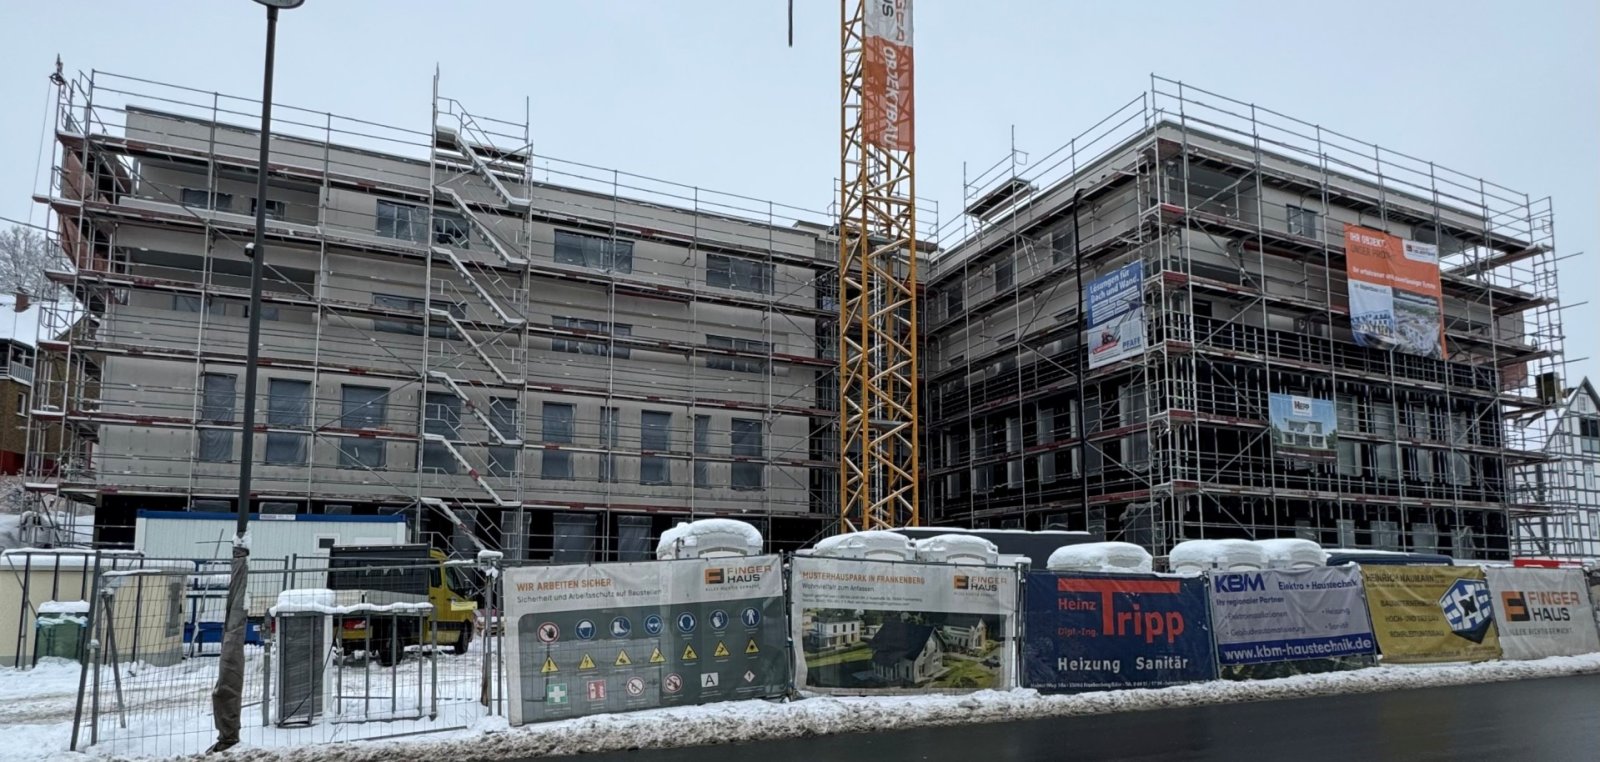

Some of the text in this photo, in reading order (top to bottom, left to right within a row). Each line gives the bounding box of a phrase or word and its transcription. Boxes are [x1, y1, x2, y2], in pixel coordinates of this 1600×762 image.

[883, 46, 899, 148] OBJEKTBAU
[1090, 269, 1130, 293] Lösungen für
[1091, 291, 1106, 303] Dach
[1106, 284, 1119, 296] und
[727, 565, 772, 575] FINGER
[517, 578, 612, 592] WIR ARBEITEN SICHER
[727, 573, 760, 583] HAUS
[802, 571, 867, 582] MUSTERHAUSPARK
[876, 576, 925, 585] FRANKENBERG
[971, 576, 1007, 585] FINGER
[1214, 573, 1265, 593] KBM
[1278, 581, 1304, 591] Elektro
[1312, 579, 1357, 590] Haustechnik
[971, 584, 998, 592] HAUS
[517, 593, 552, 603] Sicherheit
[568, 590, 614, 599] Arbeitsschutz
[1226, 598, 1258, 607] regionaler
[1528, 591, 1580, 606] FINGER
[1058, 578, 1185, 643] Heinz Tripp
[1532, 607, 1571, 621] HAUS
[1058, 628, 1098, 637] Dipl.-Ing.
[1224, 637, 1372, 661] www.kbm-haustechnik.de
[1058, 656, 1188, 674] Heizung Sanitär
[705, 675, 714, 685] A
